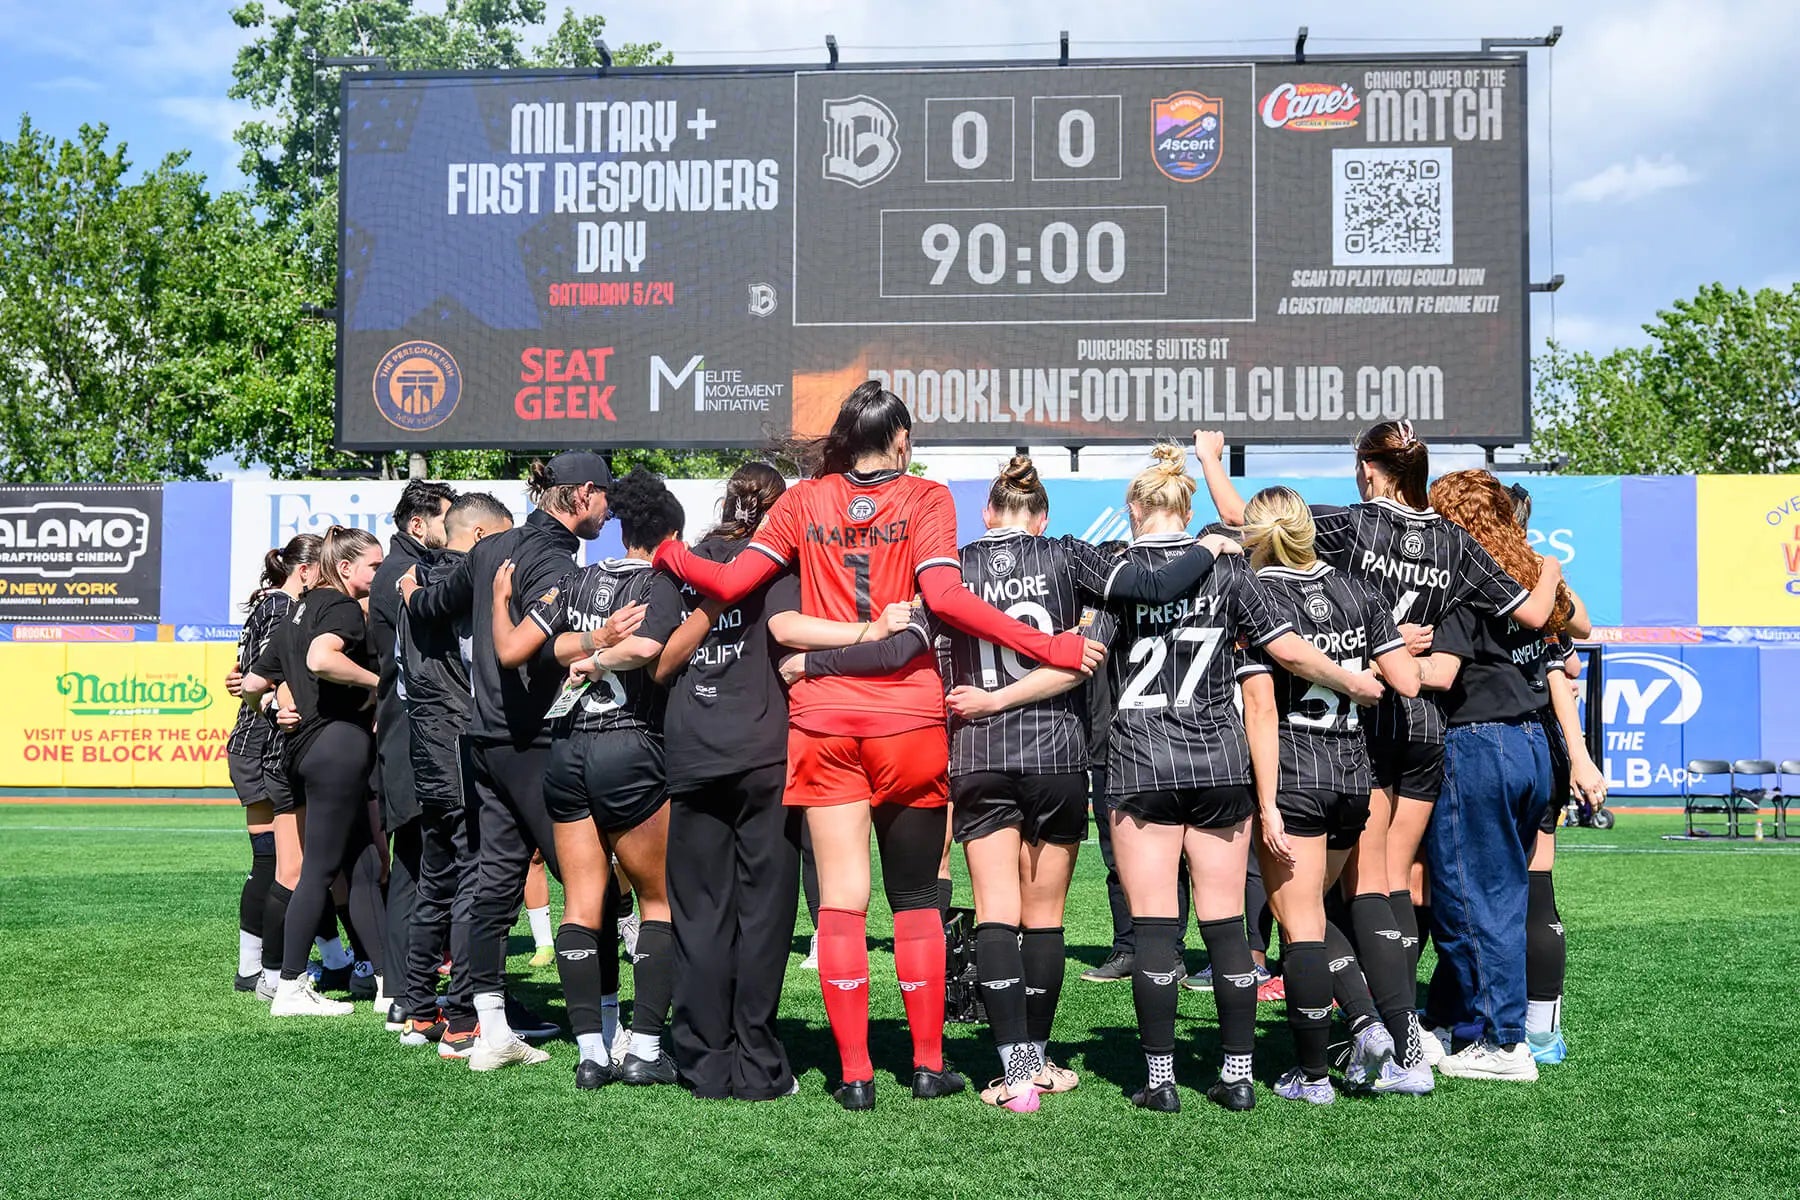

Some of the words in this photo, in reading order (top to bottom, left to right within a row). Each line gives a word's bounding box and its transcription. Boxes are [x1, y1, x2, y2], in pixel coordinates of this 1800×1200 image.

[1364, 71, 1411, 89] CANIAC
[1413, 70, 1461, 88] PLAYER
[1464, 70, 1480, 87] OF
[1482, 69, 1506, 87] THE
[1262, 83, 1360, 128] Cane's
[1366, 88, 1502, 141] MATCH
[510, 100, 677, 155] MILITARY
[951, 111, 988, 169] 0
[1058, 108, 1095, 168] 0
[1158, 137, 1216, 151] Ascent
[447, 161, 546, 215] FIRST
[554, 159, 779, 214] RESPONDERS
[577, 220, 646, 273] DAY
[921, 221, 1125, 285] 90:00
[1291, 269, 1327, 287] SCAN
[1329, 269, 1347, 287] TO
[1385, 268, 1414, 286] YOU
[1414, 268, 1457, 286] COULD
[1457, 268, 1486, 286] WIN
[549, 282, 630, 306] SATURDAY
[633, 281, 674, 306] 5/24
[1277, 297, 1287, 315] A
[1289, 297, 1343, 315] CUSTOM
[1344, 296, 1415, 314] BROOKLYN
[1416, 296, 1434, 313] FC
[1434, 296, 1473, 313] HOME
[1473, 295, 1500, 313] KIT!
[1078, 339, 1153, 361] PURCHASE
[1156, 338, 1206, 360] SUITES
[1209, 337, 1230, 360] AT
[521, 346, 615, 383] SEAT
[705, 370, 742, 383] ELITE
[514, 385, 617, 422] GEEK
[705, 384, 784, 397] MOVEMENT
[705, 399, 770, 411] INITIATIVE
[806, 519, 909, 548] MARTINEZ
[76, 552, 122, 562] CINEMA
[1361, 549, 1451, 589] PANTUSO
[10, 583, 57, 595] NEW
[64, 583, 118, 595] YORK
[843, 553, 872, 623] 1
[1136, 595, 1220, 625] PRESLEY
[15, 627, 61, 640] BROOKLYN
[1303, 626, 1367, 654] ORGE
[690, 641, 745, 665] PLIFY
[1118, 627, 1224, 710] 27
[56, 672, 208, 704] Nathan's
[24, 728, 66, 741] VISIT
[72, 729, 93, 742] US
[98, 728, 152, 741] AFTER
[157, 728, 190, 741] THE
[196, 728, 231, 741] GAM
[1606, 731, 1646, 751] THE
[23, 744, 74, 762] ONE
[82, 744, 163, 763] BLOCK
[170, 744, 229, 762] AWA
[1603, 757, 1653, 788] LB
